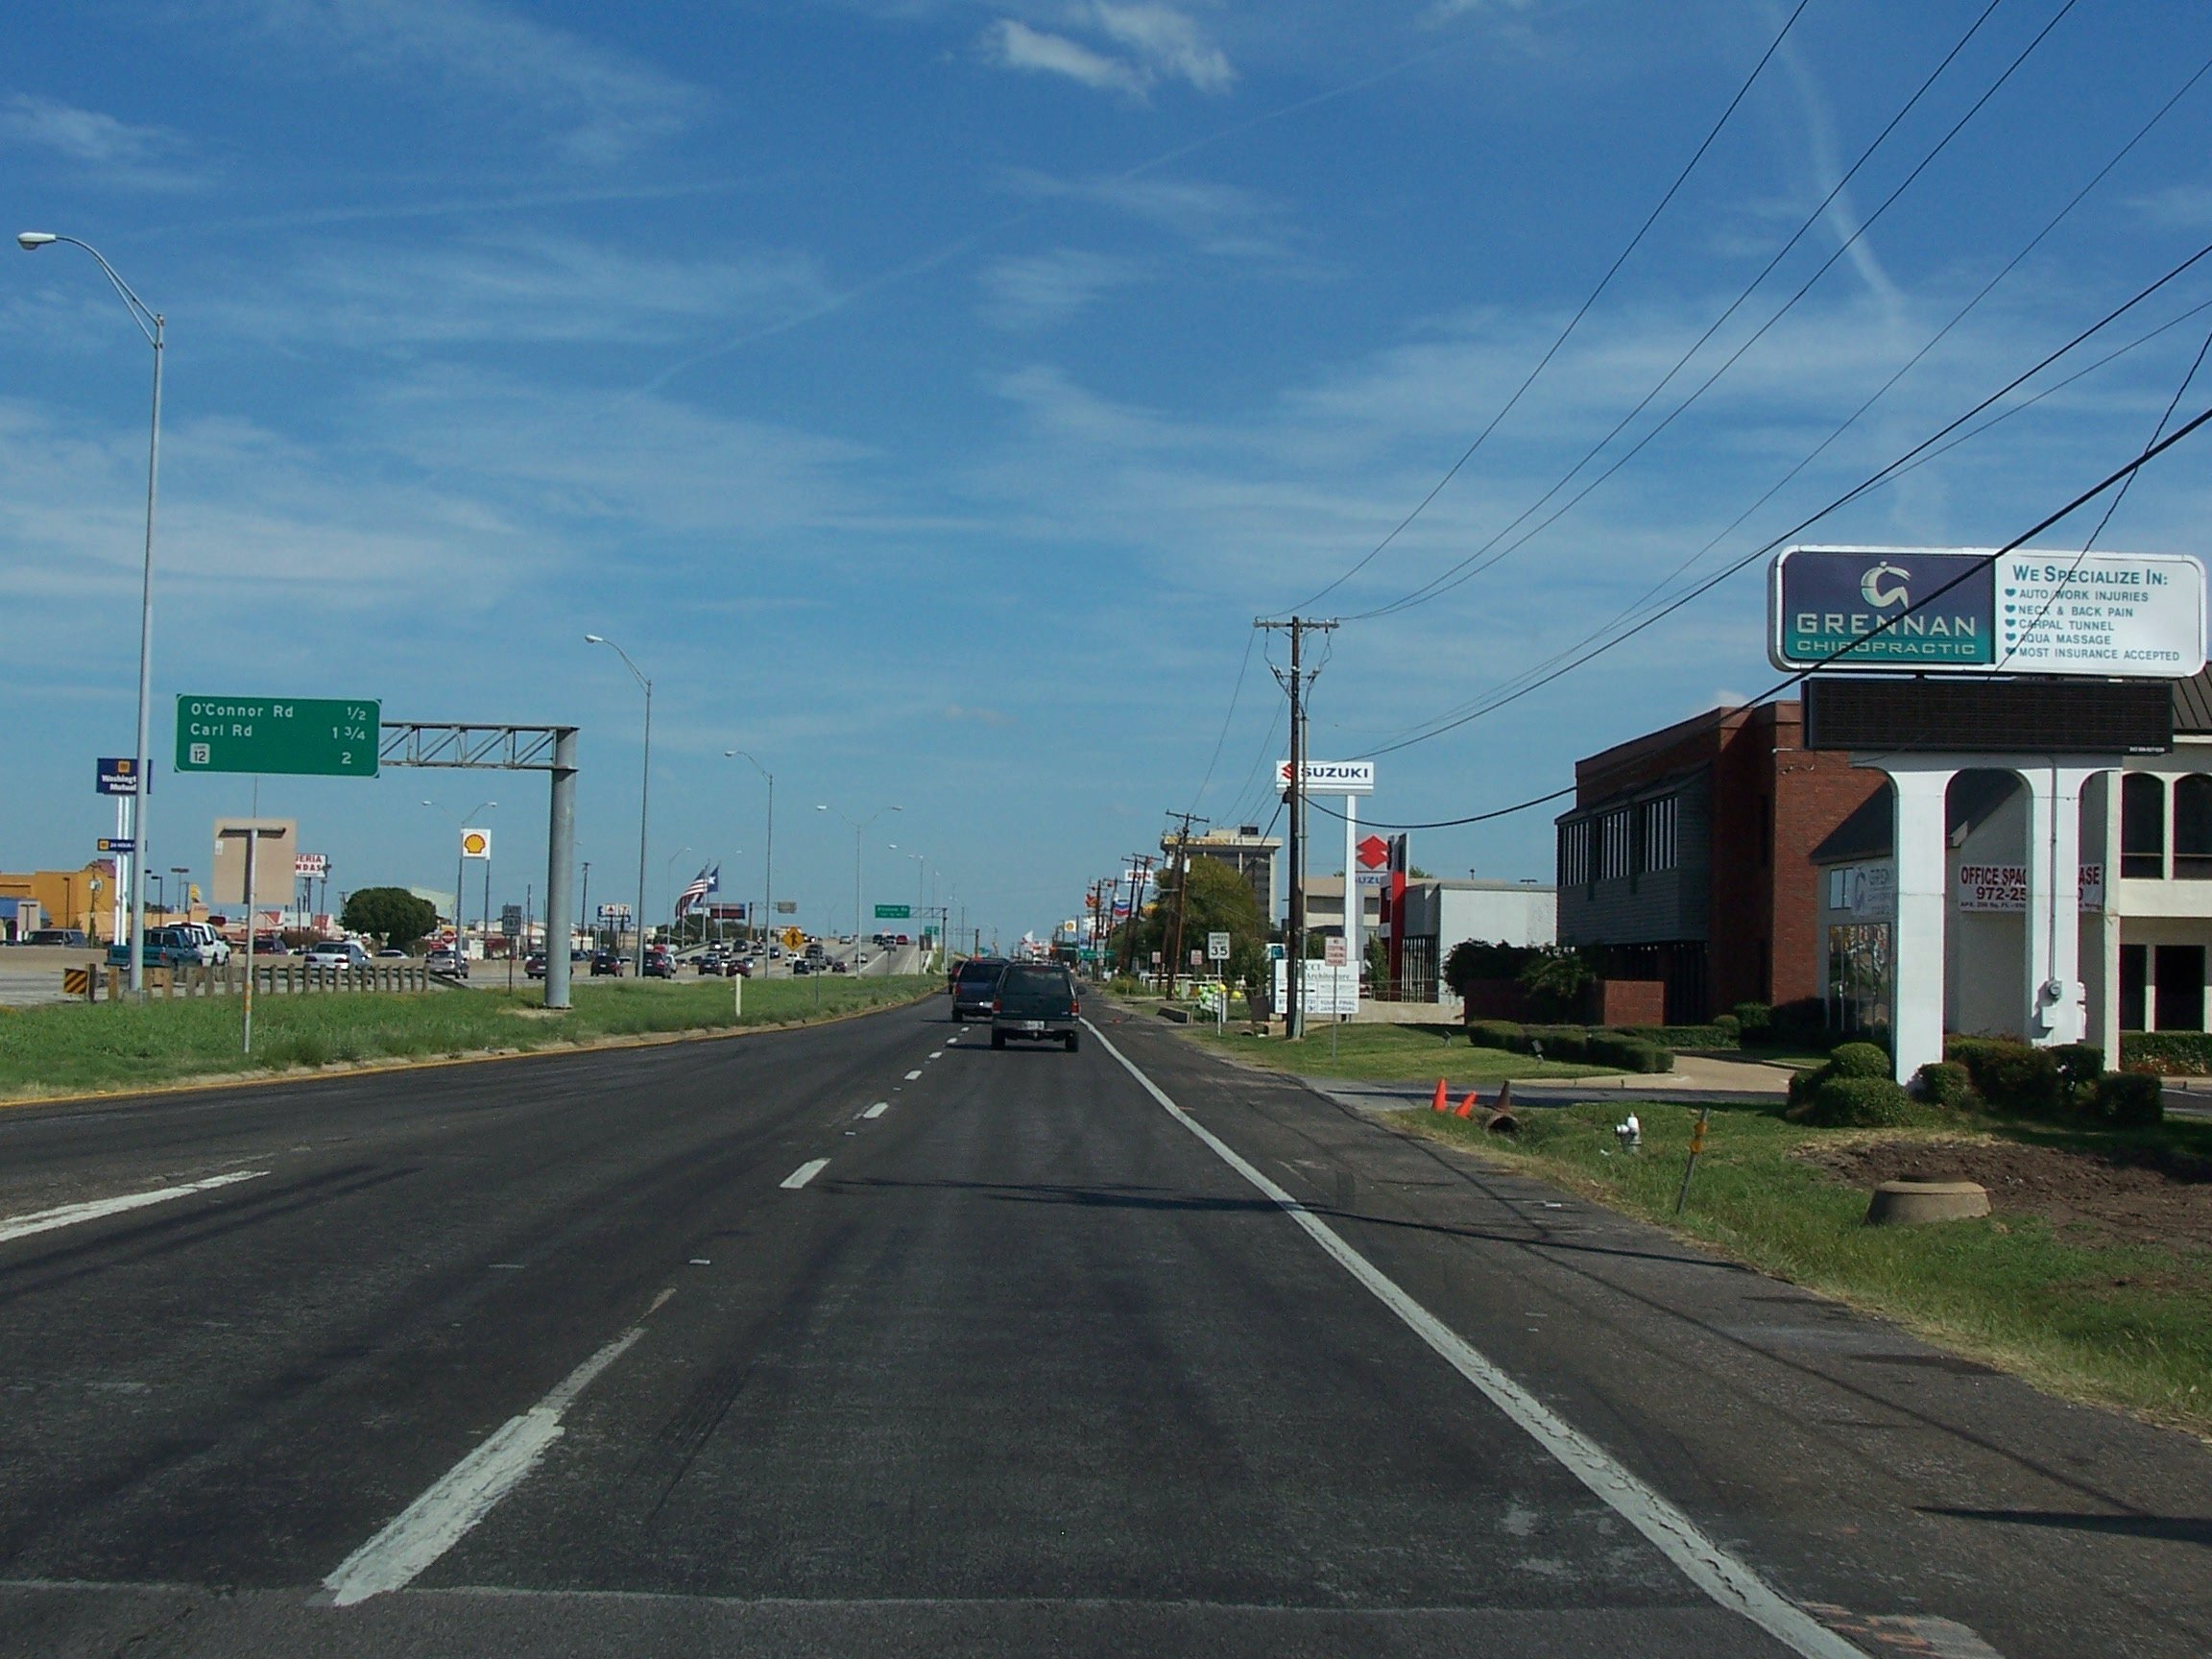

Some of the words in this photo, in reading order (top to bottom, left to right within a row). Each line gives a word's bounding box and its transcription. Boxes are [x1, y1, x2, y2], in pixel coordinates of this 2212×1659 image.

[2044, 565, 2140, 585] SPECIALIZE
[2095, 590, 2149, 602] INJURIES
[2018, 604, 2050, 615] NECK
[2056, 606, 2063, 615] &
[2071, 606, 2102, 616] BACK
[2107, 608, 2133, 617] PAIN
[1796, 613, 1976, 637] GRENNAN
[2019, 618, 2063, 630] CARPAL
[2069, 620, 2115, 631] TUNNEL
[2020, 634, 2050, 643] AQUA
[2056, 635, 2111, 644] MASSAGE
[1796, 639, 1976, 655] CHIROPRACTIC
[2019, 647, 2049, 658] MOST
[2055, 648, 2118, 659] INSURANCE
[2124, 650, 2179, 661] ACCEPTED
[191, 703, 264, 717] O'Connor
[273, 705, 294, 718] Rd
[190, 723, 224, 736] Carl
[232, 724, 252, 736] Rd
[194, 750, 206, 761] 12
[341, 752, 352, 764] 2
[1301, 767, 1368, 779] SUZUKI
[1960, 866, 1998, 885] OFFICE
[1211, 946, 1228, 955] 35
